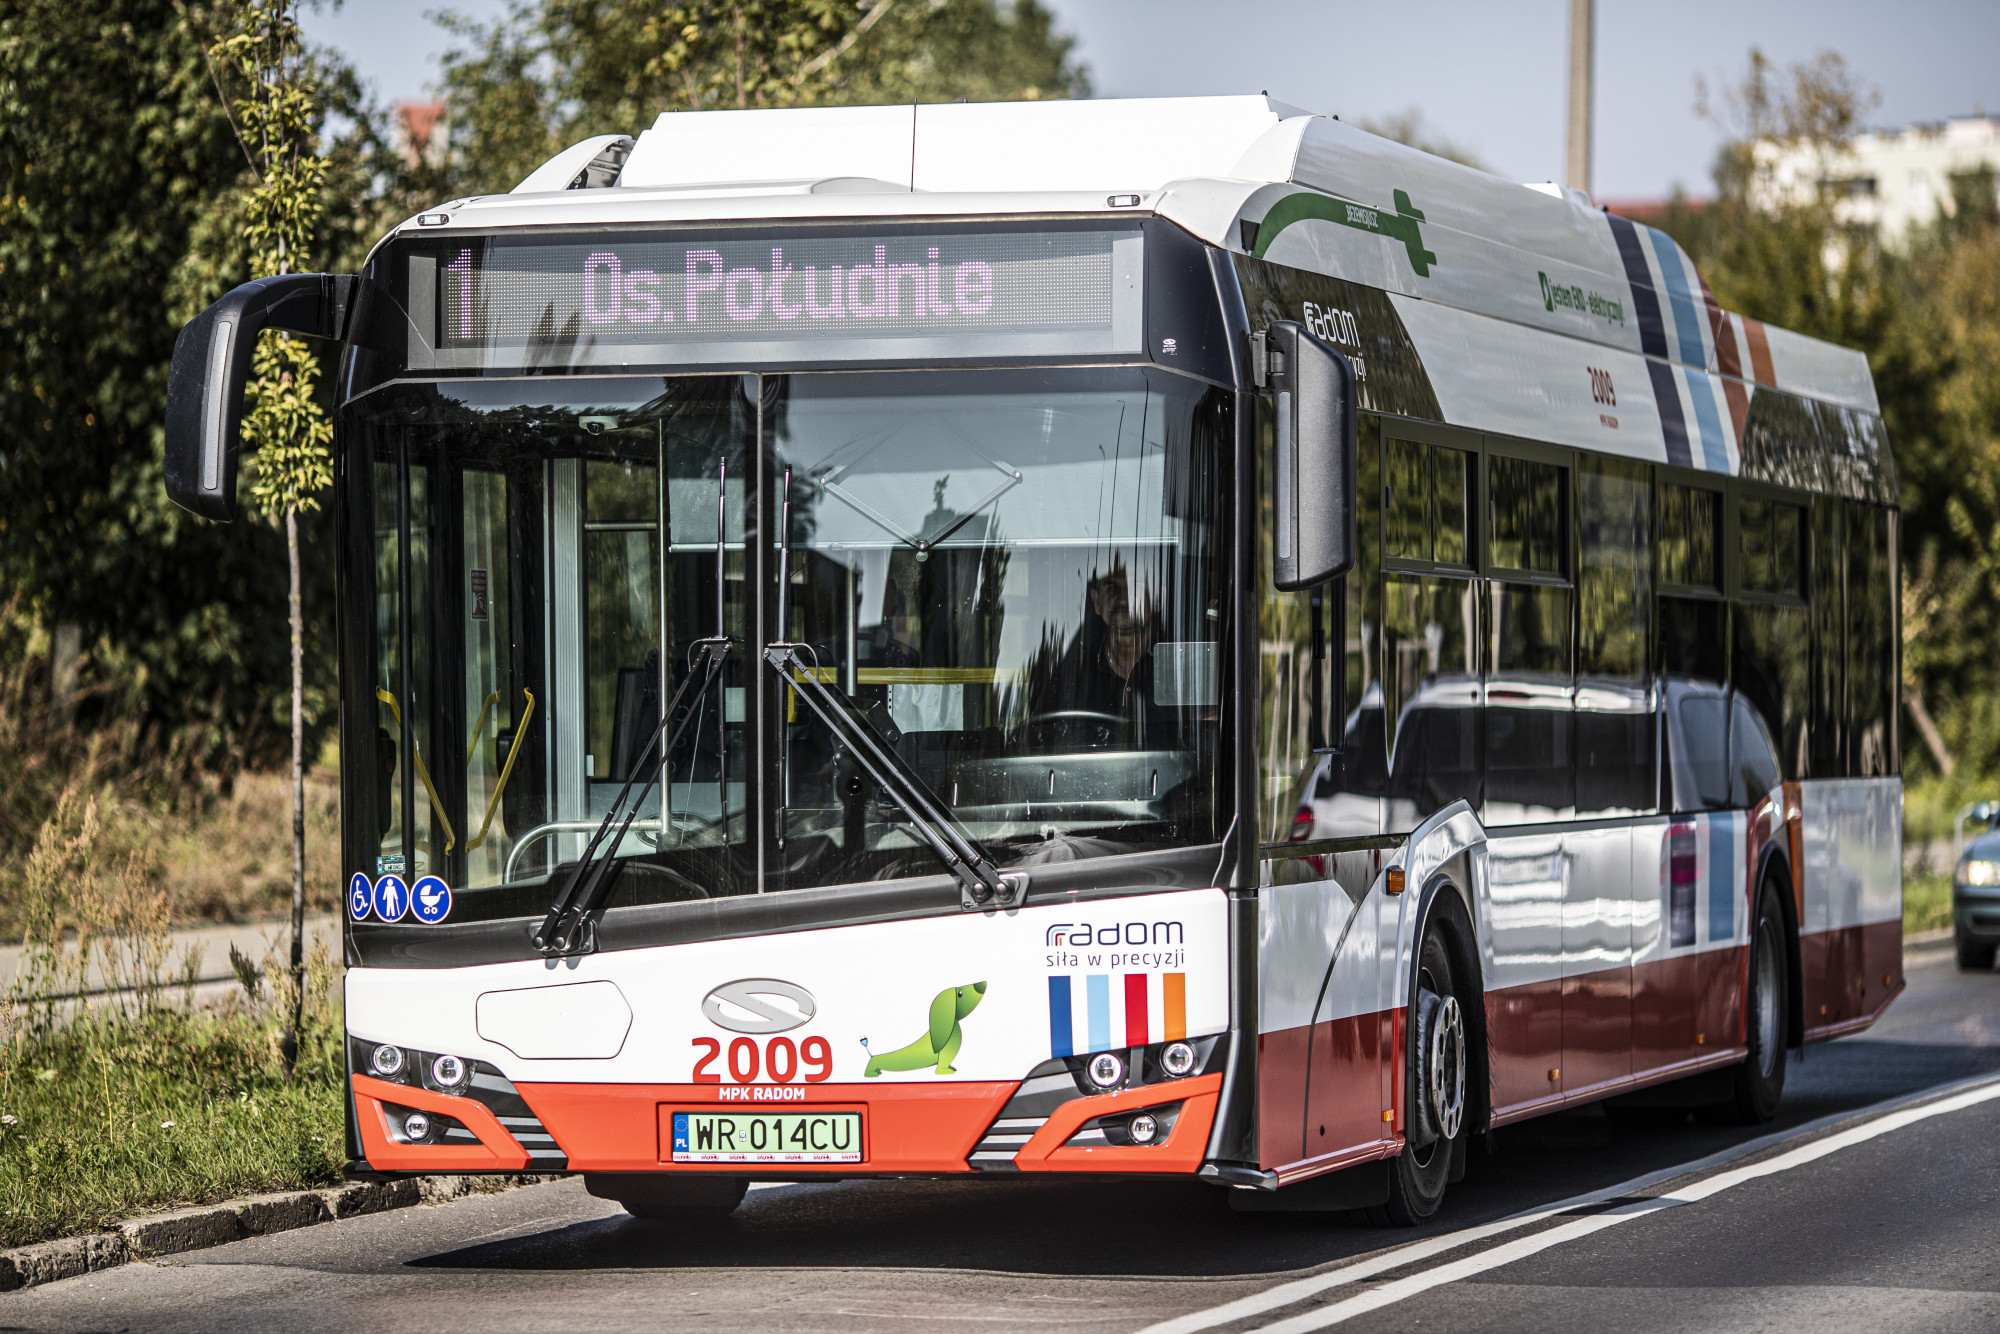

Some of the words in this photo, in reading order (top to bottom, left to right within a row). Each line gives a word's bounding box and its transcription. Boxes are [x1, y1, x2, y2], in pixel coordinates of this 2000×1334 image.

[448, 249, 471, 339] 1
[1586, 366, 1617, 408] 2009
[1046, 921, 1183, 947] radom
[1046, 951, 1078, 967] siła
[1087, 954, 1102, 966] w
[1111, 948, 1184, 969] precyzji
[692, 1035, 833, 1084] 2009
[719, 1087, 750, 1101] MPK
[753, 1087, 805, 1100] RADOM
[675, 1138, 688, 1149] PL
[696, 1118, 736, 1150] WR
[750, 1118, 851, 1150] 014CU
